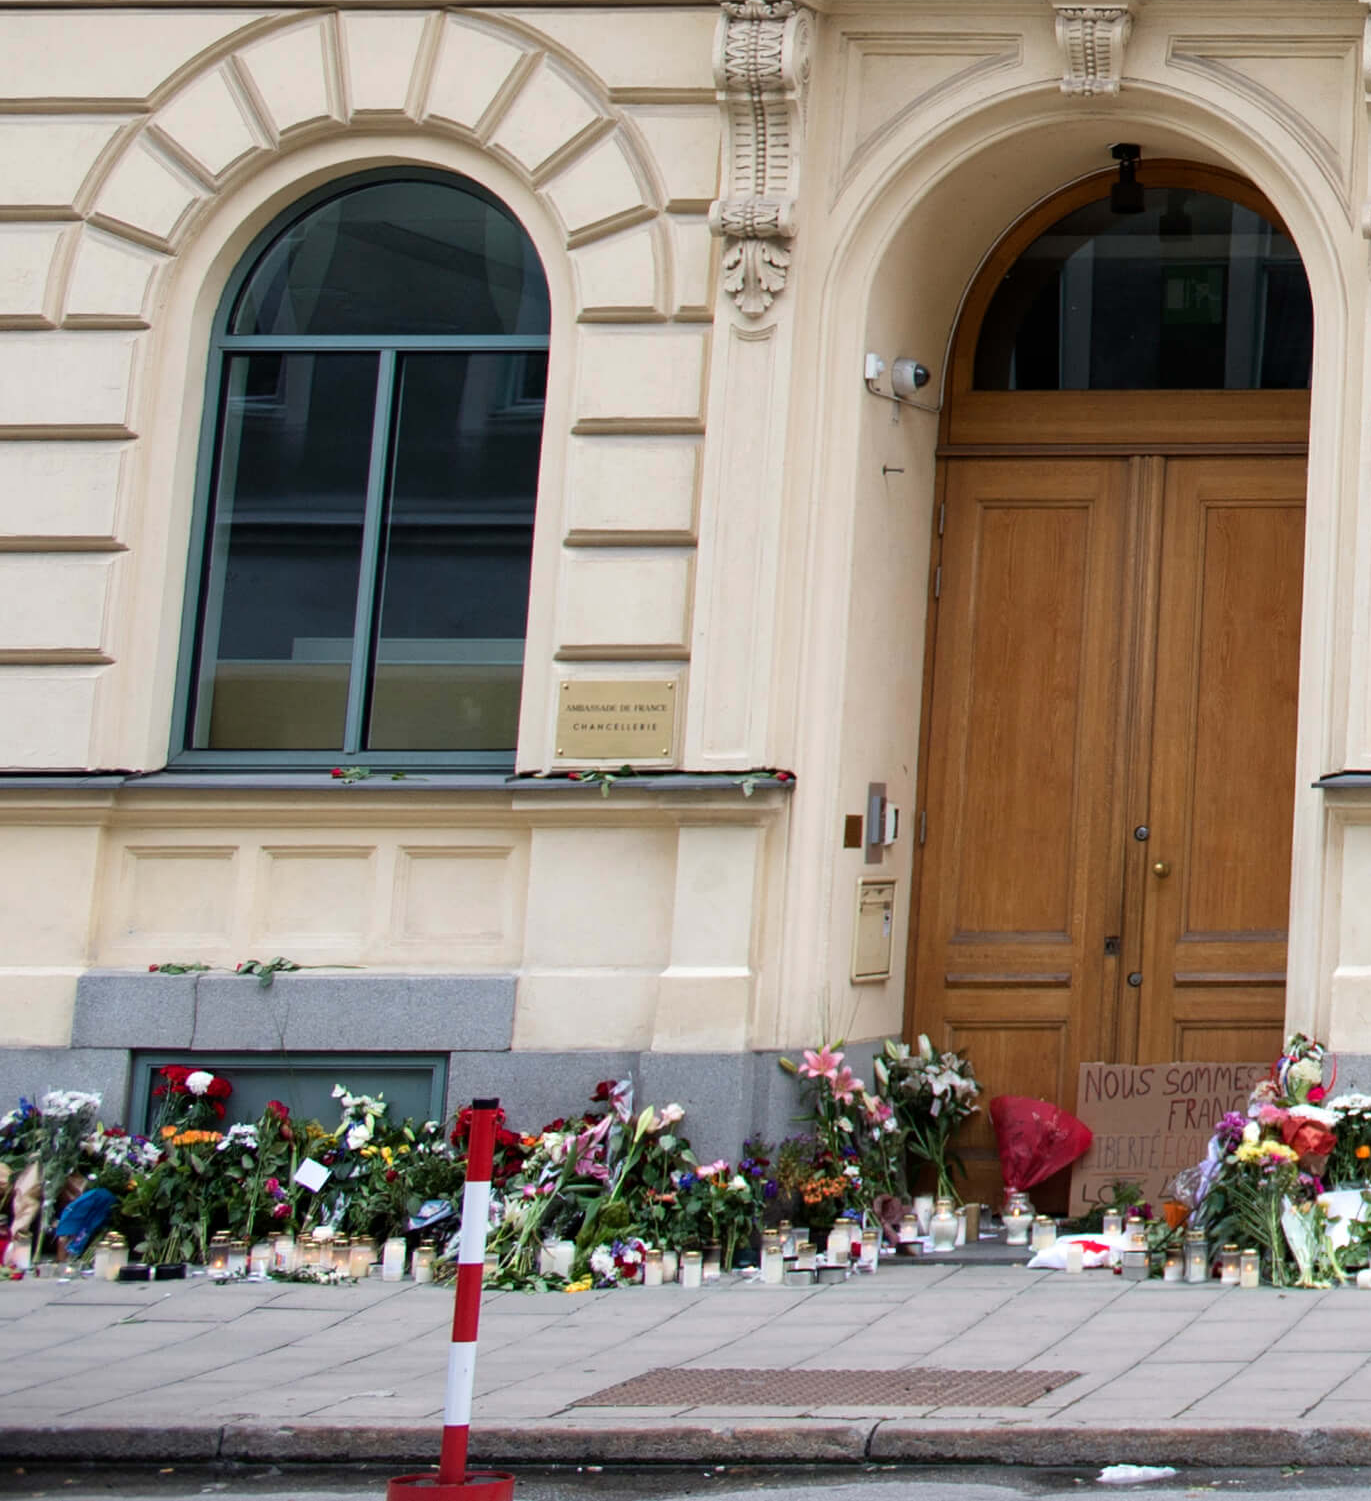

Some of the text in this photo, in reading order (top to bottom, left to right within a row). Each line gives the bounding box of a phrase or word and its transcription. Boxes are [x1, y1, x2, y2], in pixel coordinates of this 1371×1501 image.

[566, 704, 668, 713] AMBASSADE DE FRANCE
[573, 722, 657, 731] CHANCELLERIE
[1084, 1068, 1155, 1103] NOUS
[1162, 1066, 1257, 1096] SOMMES
